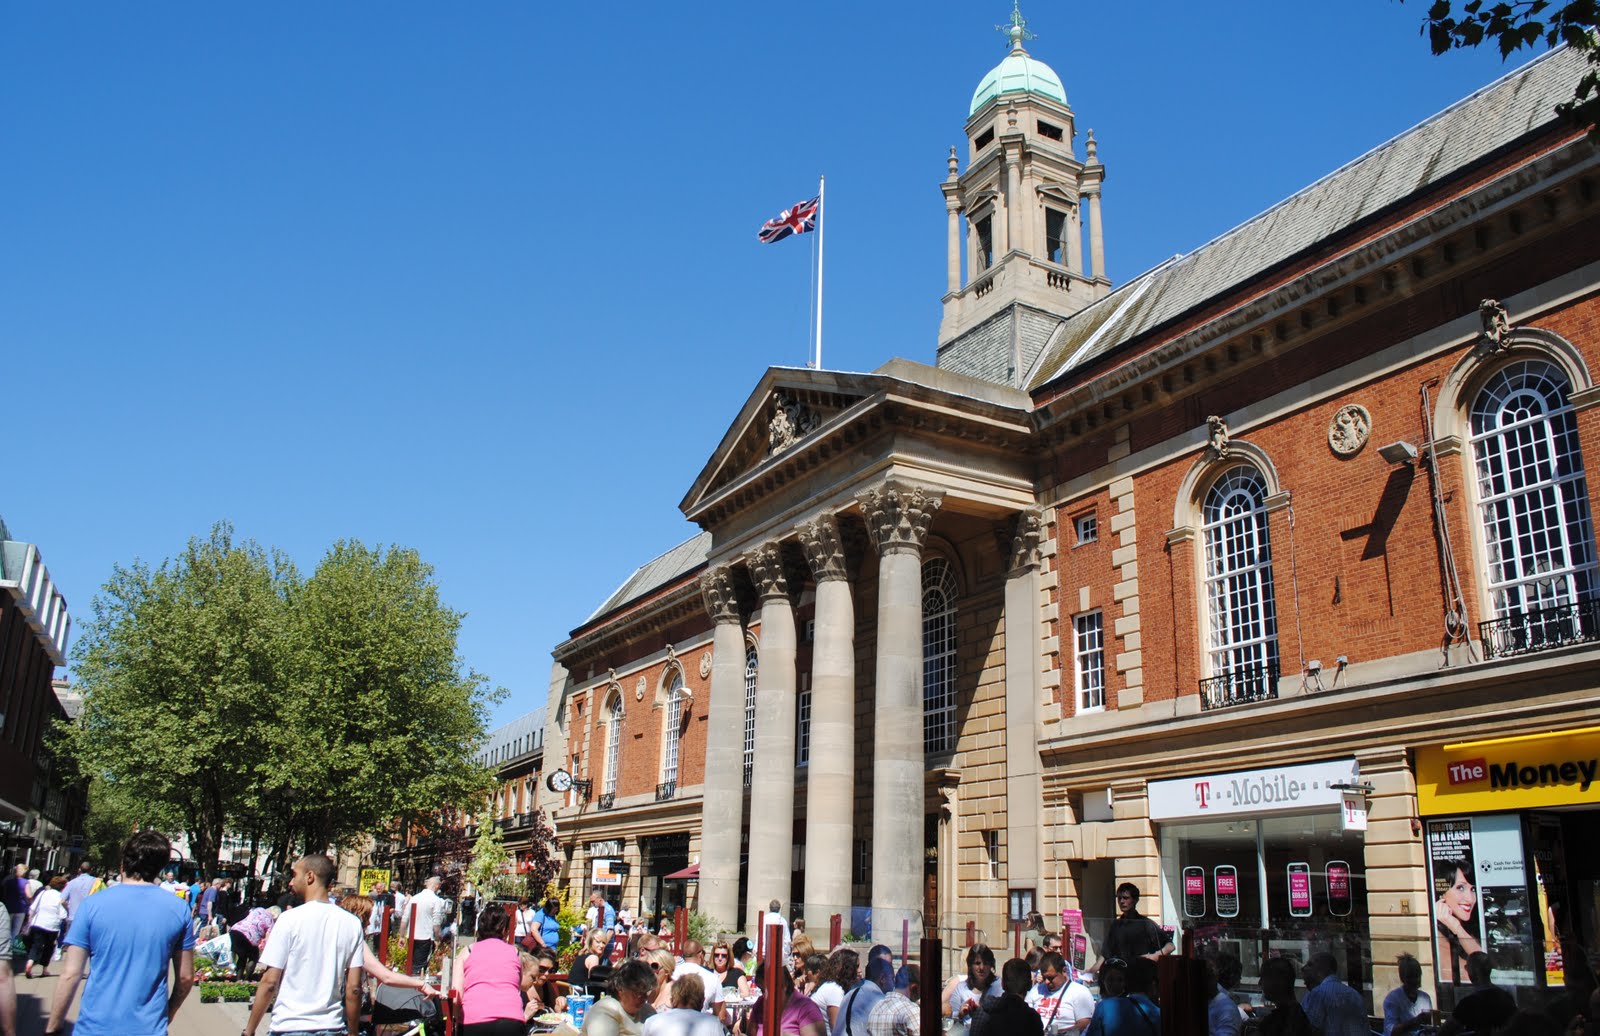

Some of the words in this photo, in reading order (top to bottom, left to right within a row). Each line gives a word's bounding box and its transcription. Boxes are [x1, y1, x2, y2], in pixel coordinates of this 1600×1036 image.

[1450, 764, 1483, 782] The
[1489, 759, 1597, 789] Money
[1231, 774, 1300, 806] Mobile
[1344, 800, 1357, 823] T
[1431, 832, 1439, 842] IN
[1440, 832, 1446, 842] A
[1447, 830, 1470, 841] FLASH
[1187, 879, 1201, 887] FREE
[1218, 878, 1234, 887] FREE
